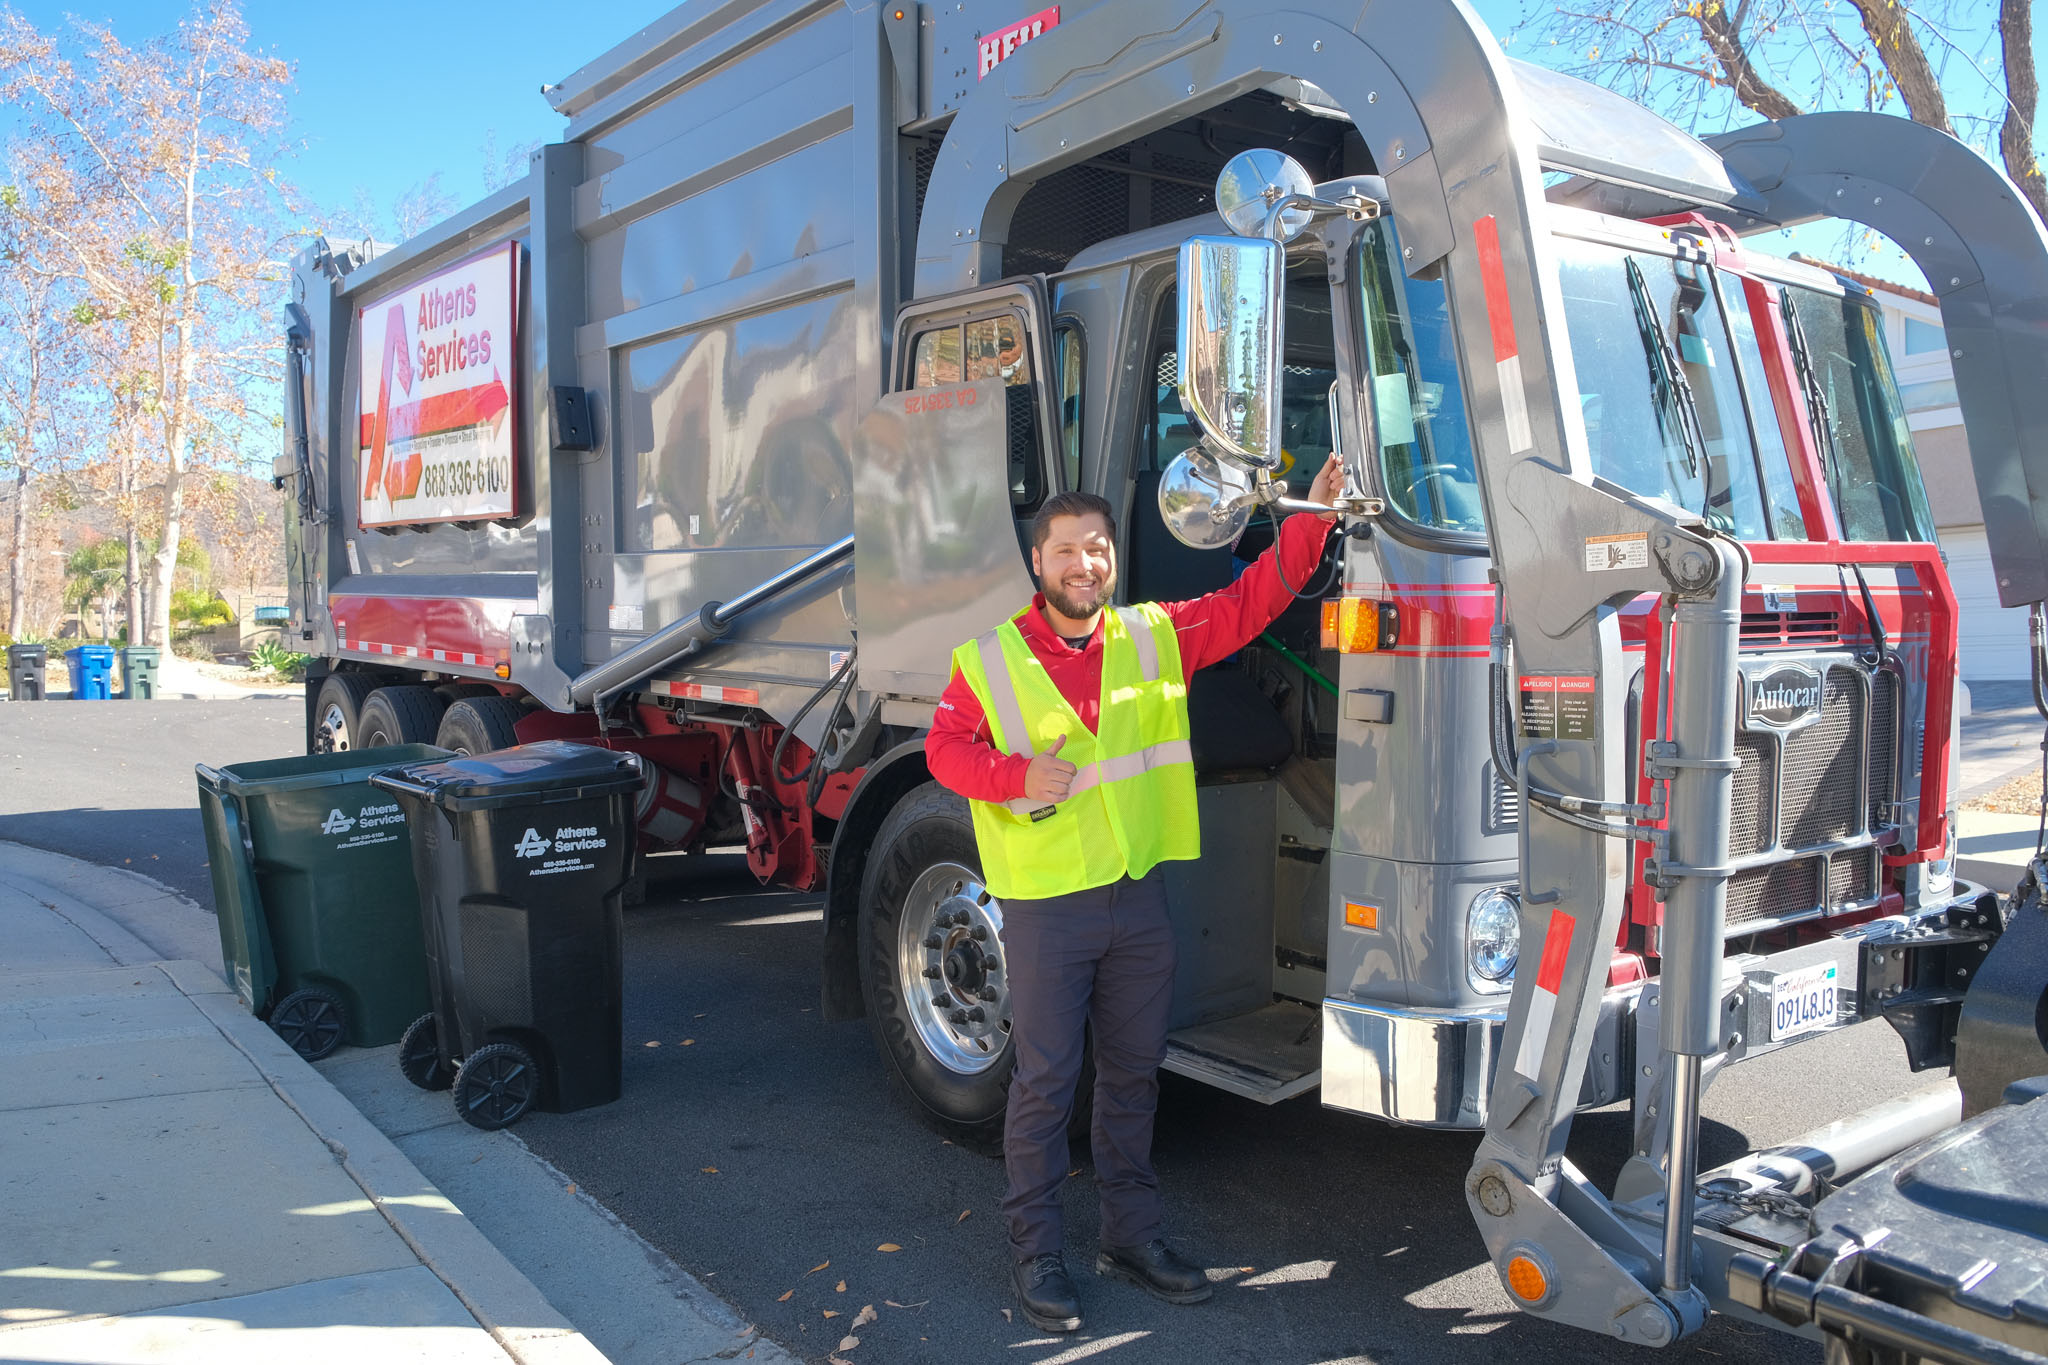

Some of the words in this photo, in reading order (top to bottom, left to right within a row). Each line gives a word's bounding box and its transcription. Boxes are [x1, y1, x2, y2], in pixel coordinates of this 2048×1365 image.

[417, 282, 476, 335] Athens
[416, 329, 491, 381] Services
[904, 391, 953, 414] 335125
[956, 388, 977, 407] CA
[425, 455, 509, 498] 888/336-6100
[1752, 682, 1818, 711] Autocar
[360, 803, 399, 817] Athens
[359, 813, 406, 829] Services
[555, 826, 598, 840] Athens
[554, 838, 607, 853] Services
[529, 863, 595, 876] AthensServices.com
[1777, 987, 1834, 1031] 09148J3
